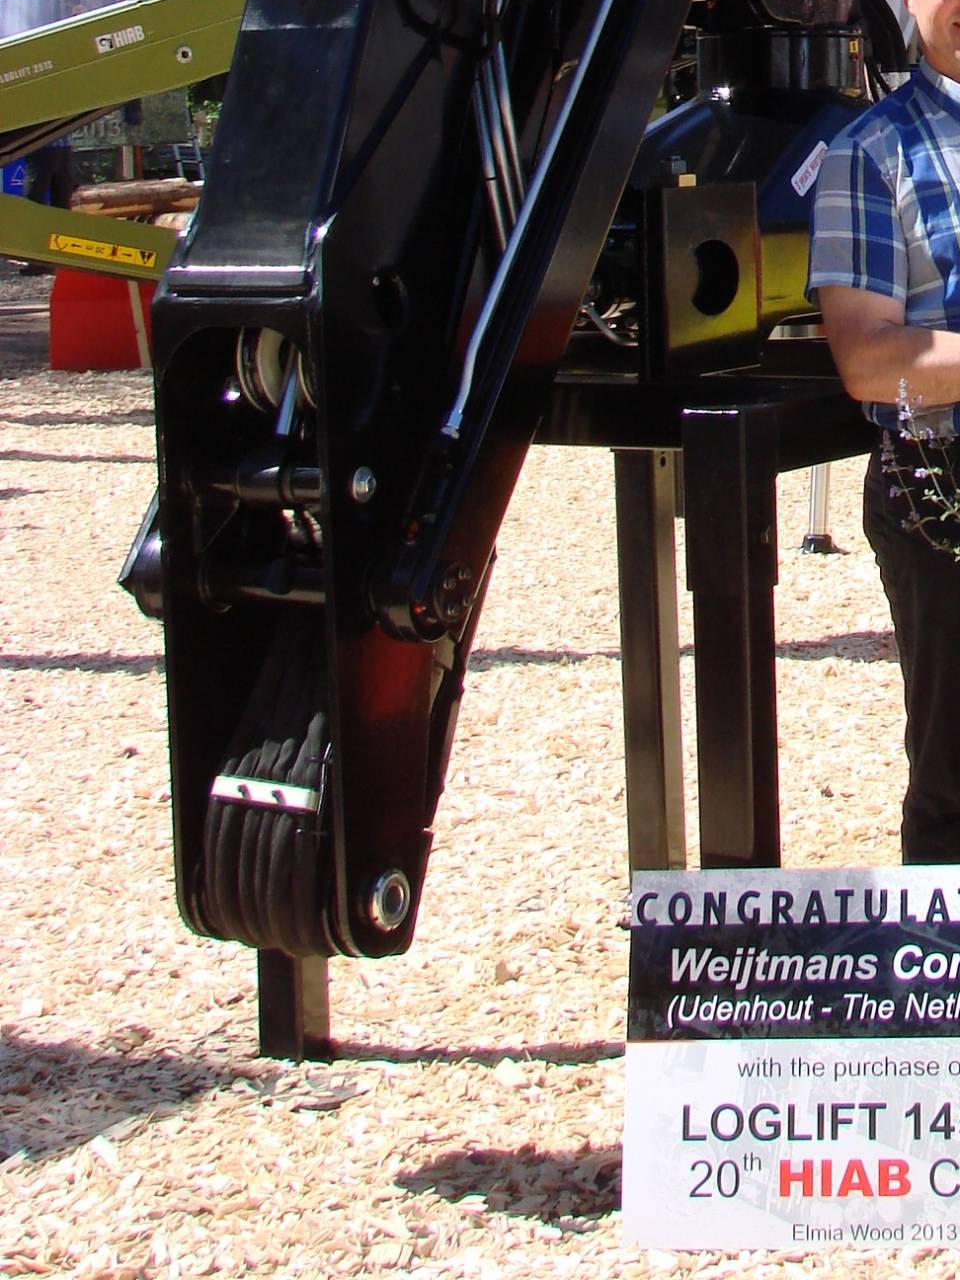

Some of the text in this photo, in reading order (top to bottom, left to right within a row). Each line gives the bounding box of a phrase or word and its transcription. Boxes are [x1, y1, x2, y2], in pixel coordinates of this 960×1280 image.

[112, 24, 146, 48] HIAB
[671, 947, 879, 991] Weijtmans
[667, 994, 815, 1029] (Udenhout
[844, 993, 896, 1020] The
[737, 1056, 782, 1078] with
[791, 1056, 826, 1078] the
[834, 1055, 940, 1082] purchase
[681, 1102, 888, 1142] LOGLIFT
[779, 1158, 912, 1198] HIAB
[791, 1222, 959, 1242] Elmia Wood 2013
